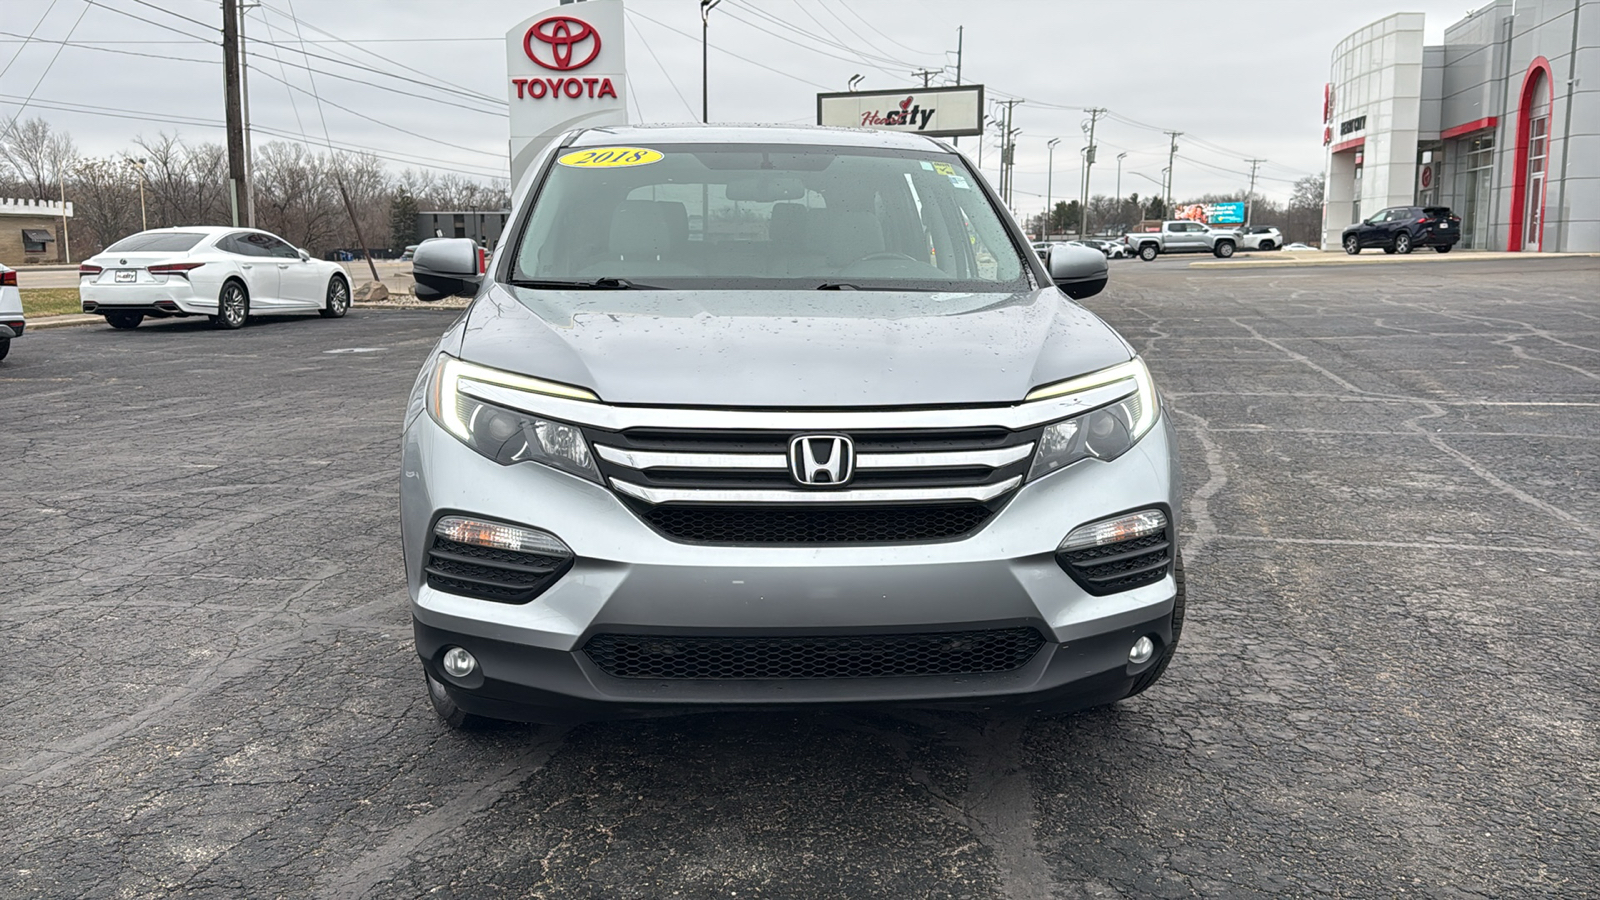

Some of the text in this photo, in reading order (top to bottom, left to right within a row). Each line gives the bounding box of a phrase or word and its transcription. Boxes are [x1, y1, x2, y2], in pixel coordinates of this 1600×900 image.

[512, 78, 617, 99] TOYOTA
[861, 104, 935, 130] Heart city
[574, 151, 648, 165] 2018
